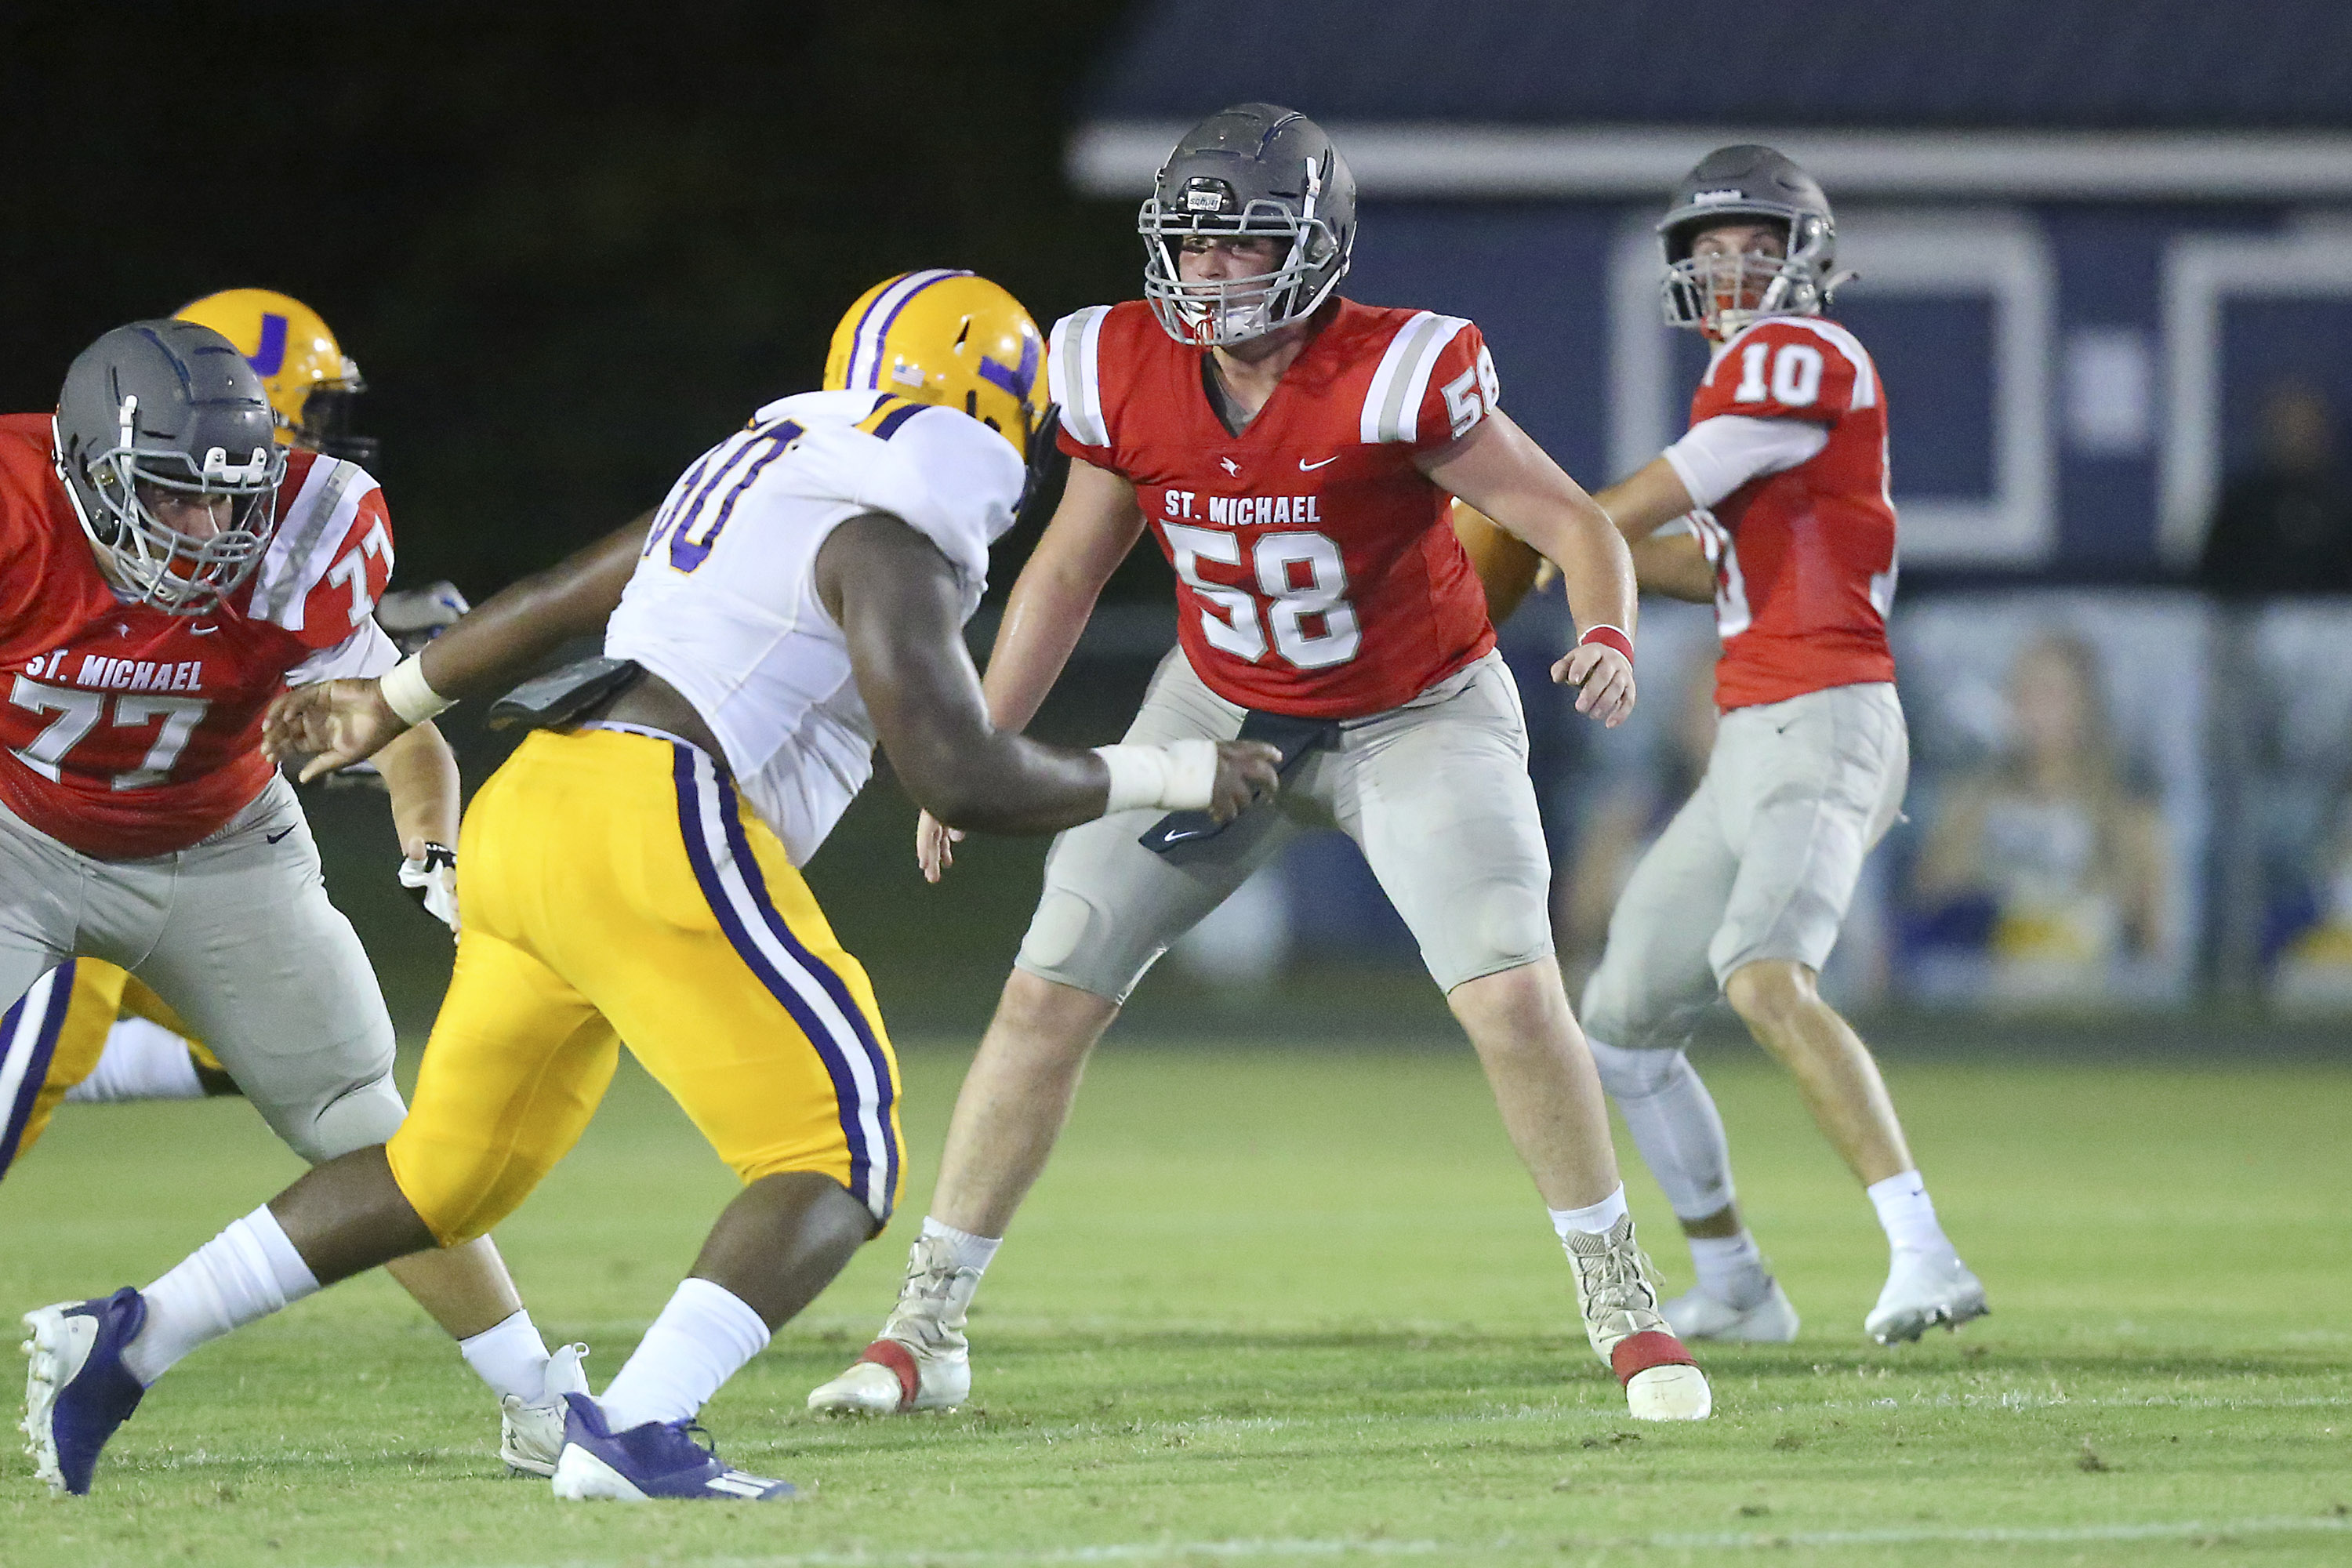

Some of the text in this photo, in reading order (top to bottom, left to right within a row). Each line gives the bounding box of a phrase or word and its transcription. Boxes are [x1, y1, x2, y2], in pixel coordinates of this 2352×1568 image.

[1439, 344, 1500, 441] 58
[1734, 342, 1823, 406] 10
[1165, 489, 1321, 525] ST. MICHAEL
[325, 514, 394, 627] 77
[1159, 517, 1363, 669] 58
[26, 648, 202, 691] ST. MICHAEL
[6, 671, 213, 791] 77
